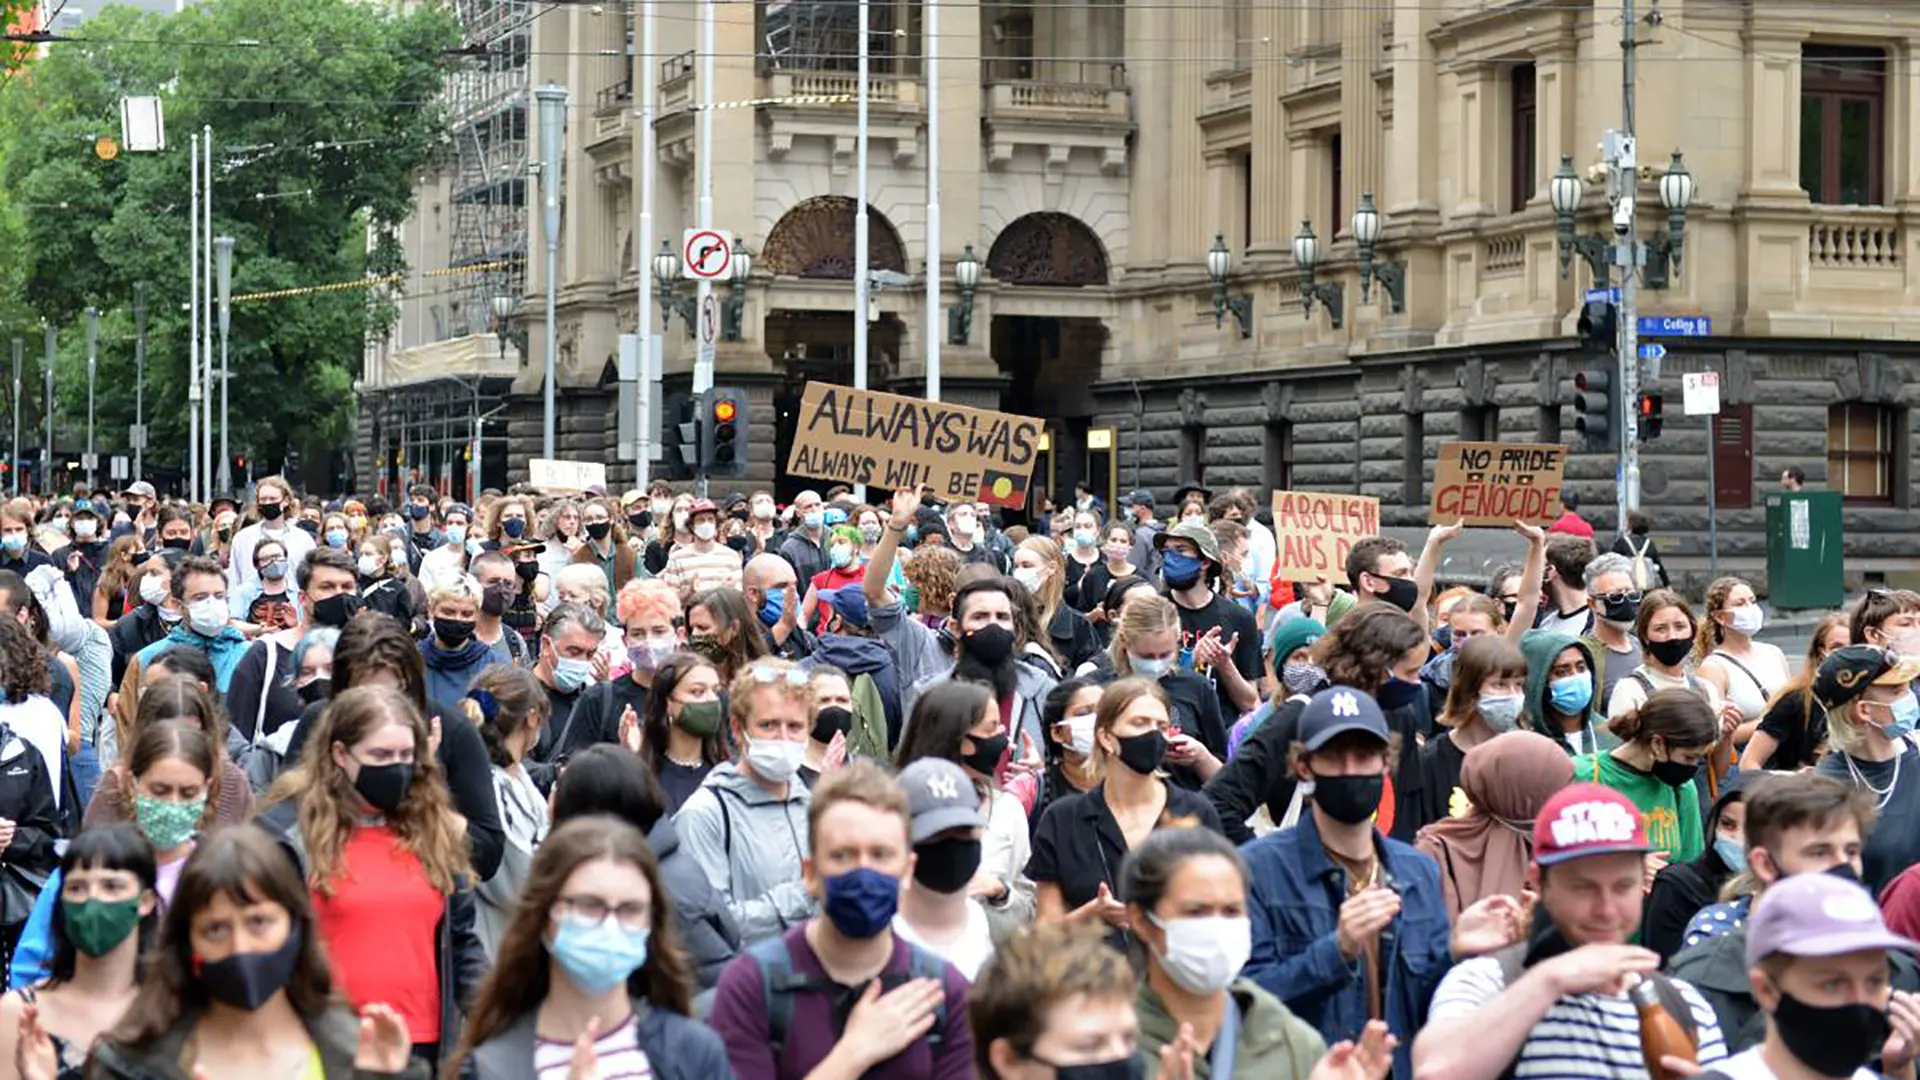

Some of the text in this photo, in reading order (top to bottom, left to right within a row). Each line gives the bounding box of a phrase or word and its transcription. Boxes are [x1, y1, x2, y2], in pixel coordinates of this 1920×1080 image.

[808, 389, 1037, 466] ALWAYS WAS
[792, 444, 979, 497] ALWAYS WILL BE
[1460, 447, 1560, 471] NO PRIDE
[1491, 473, 1510, 485] IN
[1281, 494, 1377, 536] ABOLISH
[1436, 484, 1559, 520] GENOCIDE
[1282, 534, 1328, 570] AUS
